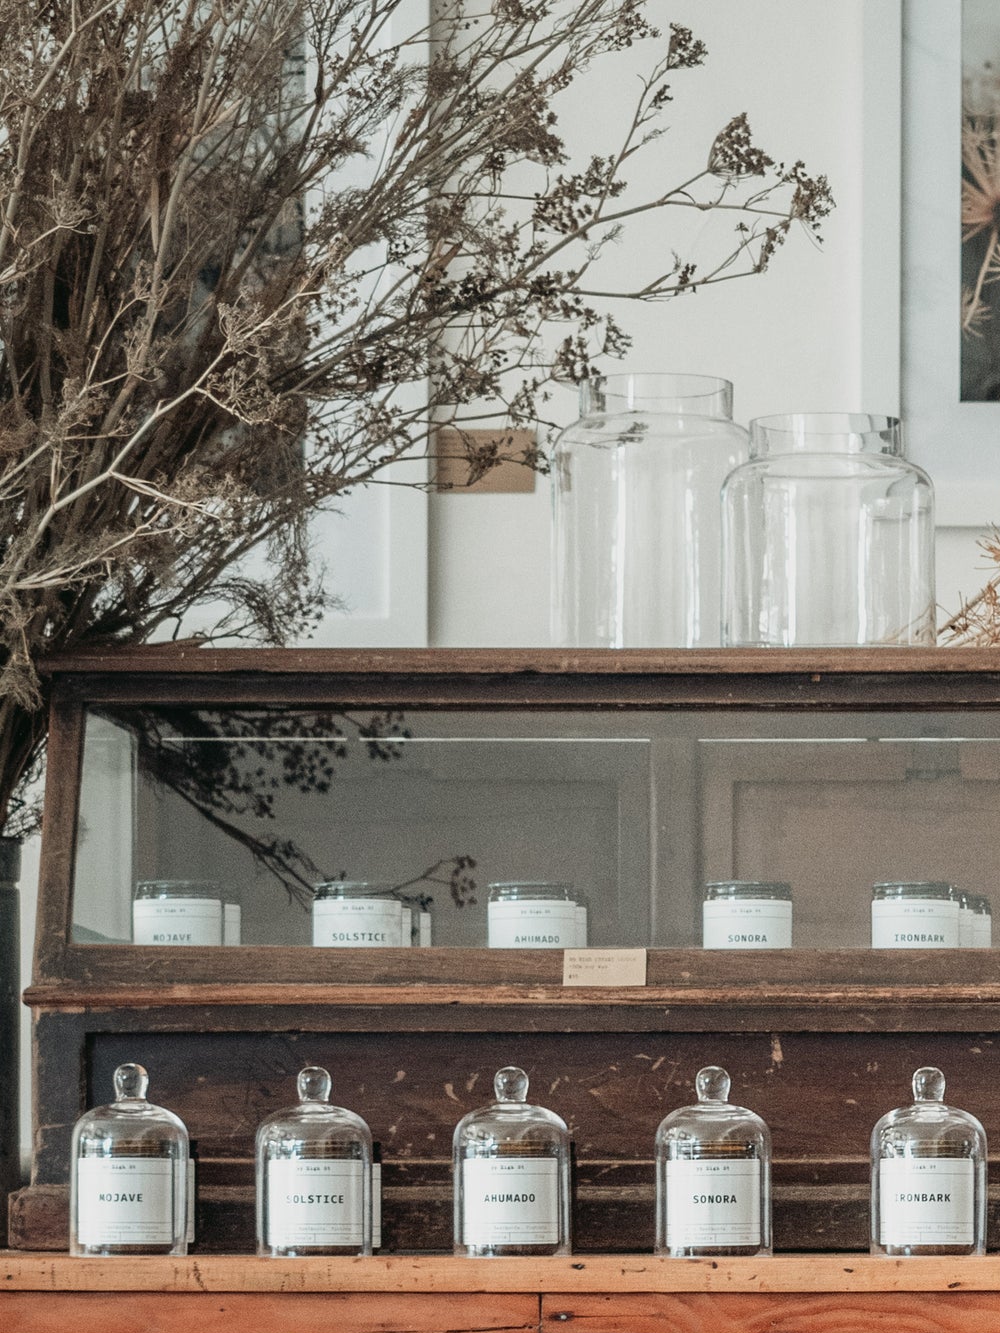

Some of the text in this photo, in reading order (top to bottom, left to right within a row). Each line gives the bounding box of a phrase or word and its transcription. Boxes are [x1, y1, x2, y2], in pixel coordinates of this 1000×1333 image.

[153, 933, 192, 943] MOJAVE
[332, 932, 386, 942] SOLSTICE
[514, 934, 560, 944] AHUMADO
[727, 934, 768, 943] SONORA
[894, 933, 945, 943] IRONBARK
[99, 1192, 144, 1203] MOJAVE
[286, 1193, 345, 1204] SOLSTICE
[484, 1193, 536, 1203] AHUMADO
[693, 1193, 737, 1204] SONORA
[895, 1192, 951, 1203] IRONBARK
